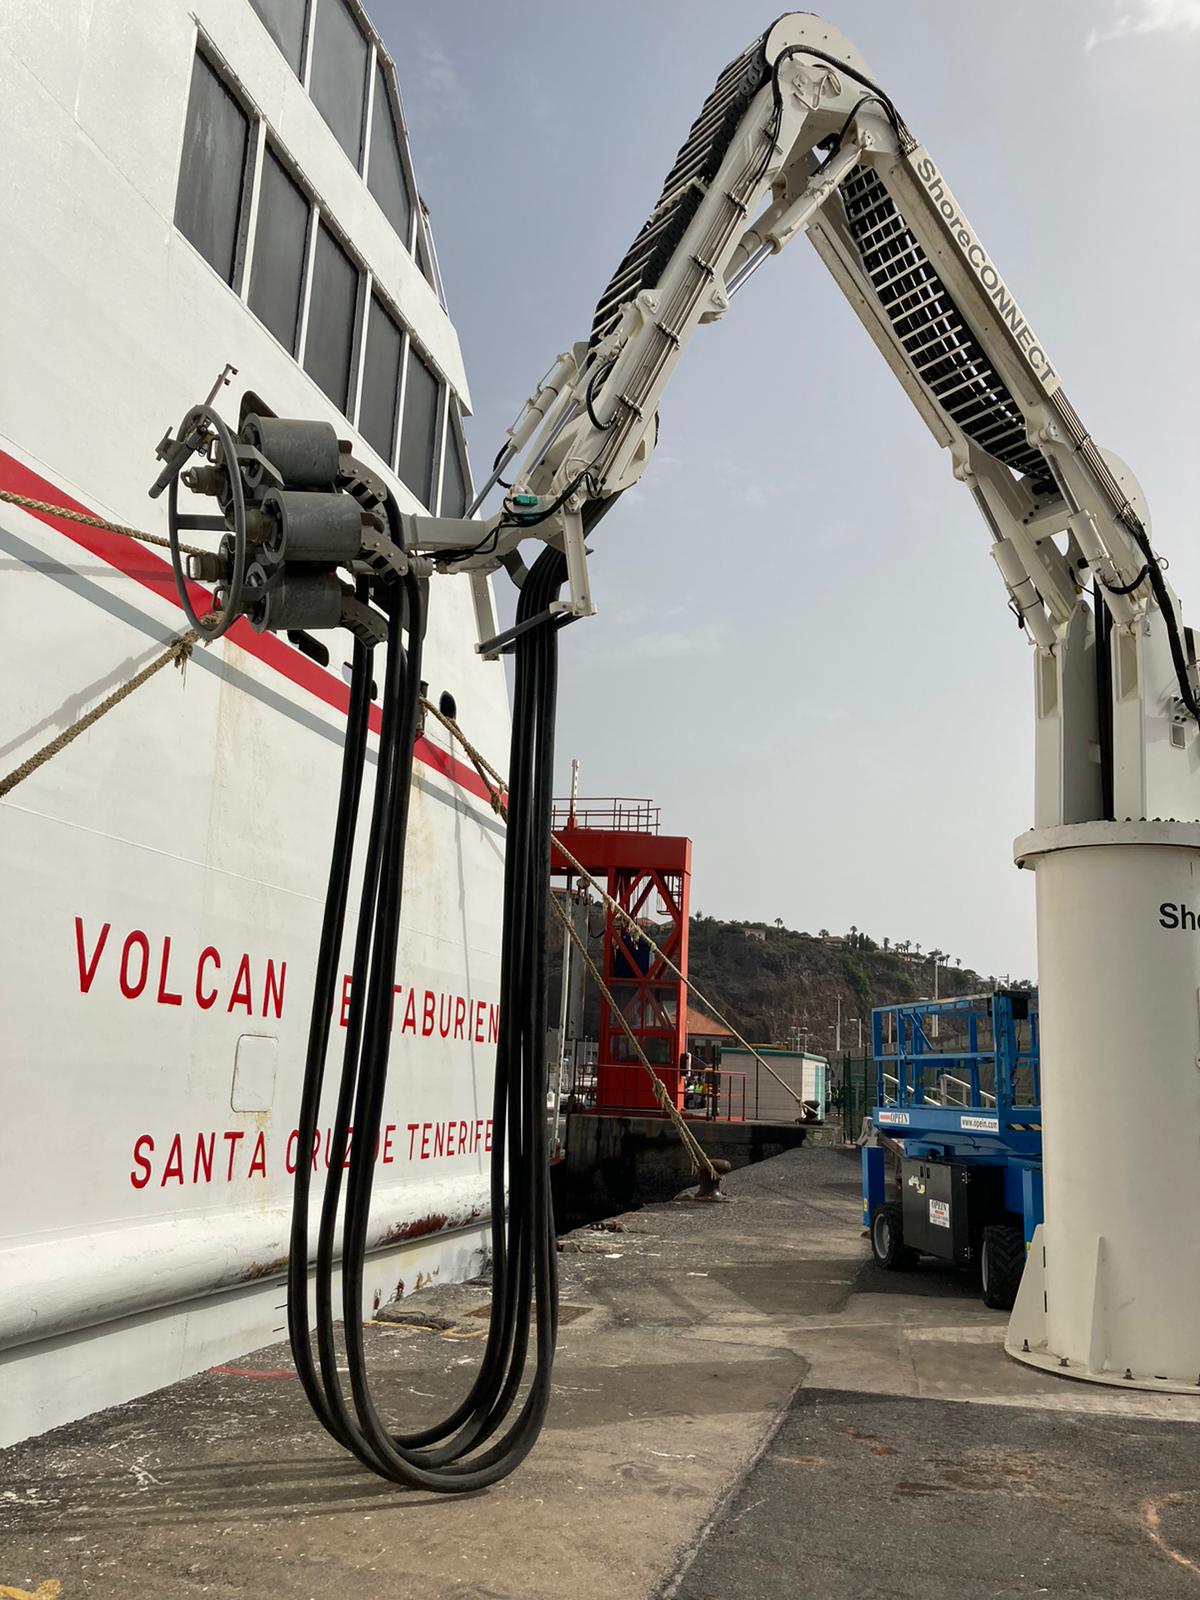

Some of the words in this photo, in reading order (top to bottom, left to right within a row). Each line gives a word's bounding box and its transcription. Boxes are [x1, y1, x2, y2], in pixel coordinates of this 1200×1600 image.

[917, 158, 1056, 384] ShoreCONNECT
[1159, 902, 1200, 931] Sh
[74, 916, 288, 1019] VOLCAN
[129, 1131, 267, 1189] SANTA
[407, 1119, 494, 1160] TENERIFE
